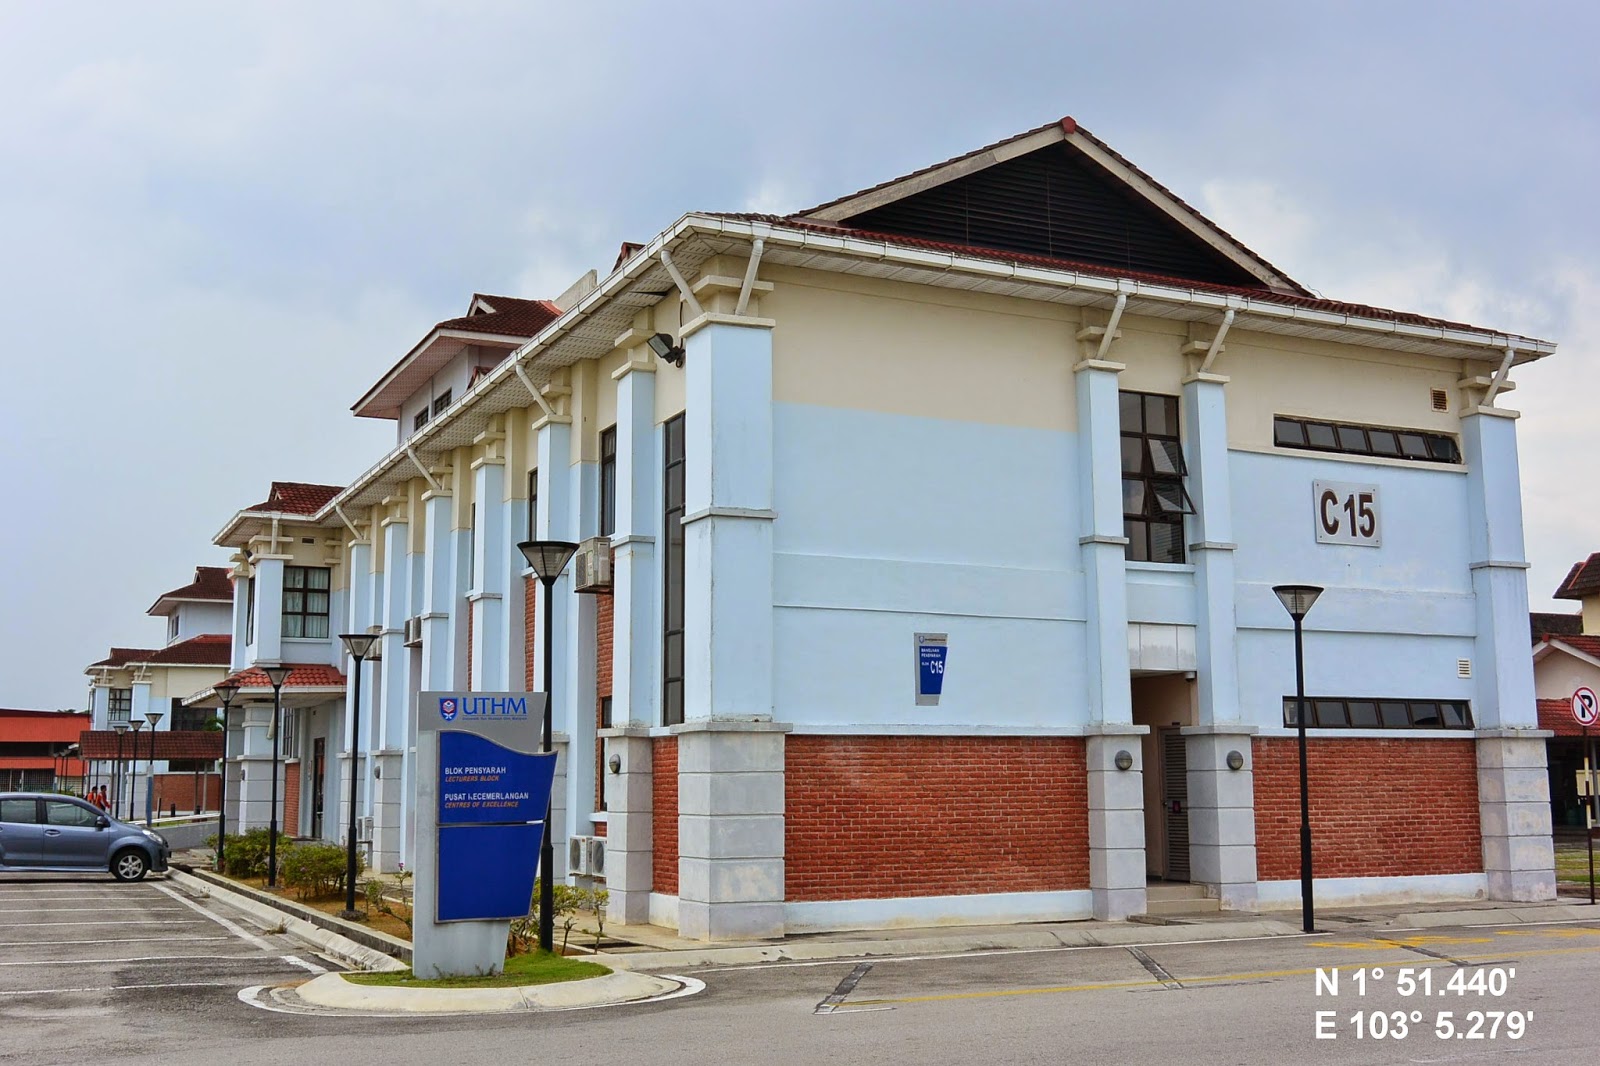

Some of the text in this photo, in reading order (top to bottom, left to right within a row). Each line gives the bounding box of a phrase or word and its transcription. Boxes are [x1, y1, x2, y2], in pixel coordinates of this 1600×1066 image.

[930, 660, 944, 674] C15
[462, 697, 527, 715] UTHM
[1580, 694, 1593, 718] P
[444, 766, 506, 775] BLOK PENSYARAH
[445, 775, 478, 783] LECTURERS
[444, 793, 466, 801] PUSAT
